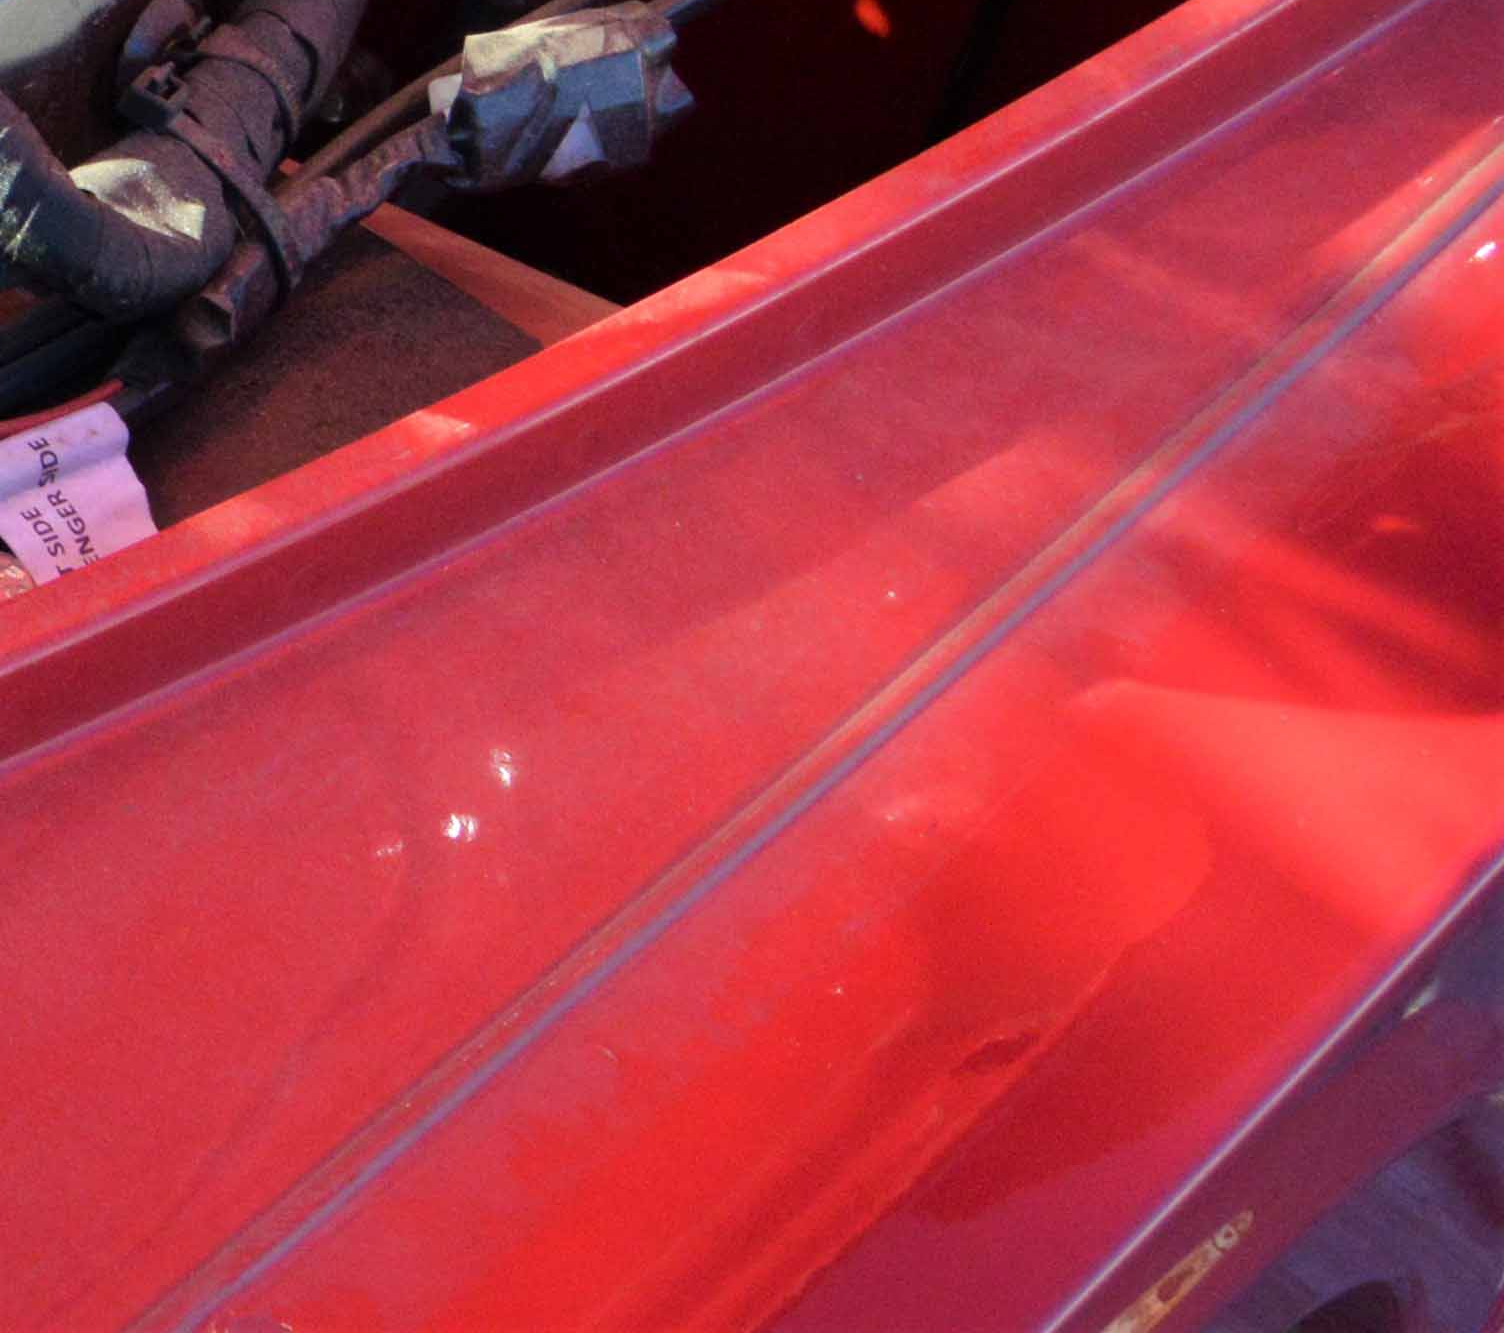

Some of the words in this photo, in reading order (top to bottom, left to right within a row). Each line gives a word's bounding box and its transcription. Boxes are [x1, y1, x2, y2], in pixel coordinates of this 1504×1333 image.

[28, 436, 61, 488] SIDE
[20, 507, 66, 557] SIDE
[47, 489, 99, 567] ENGER
